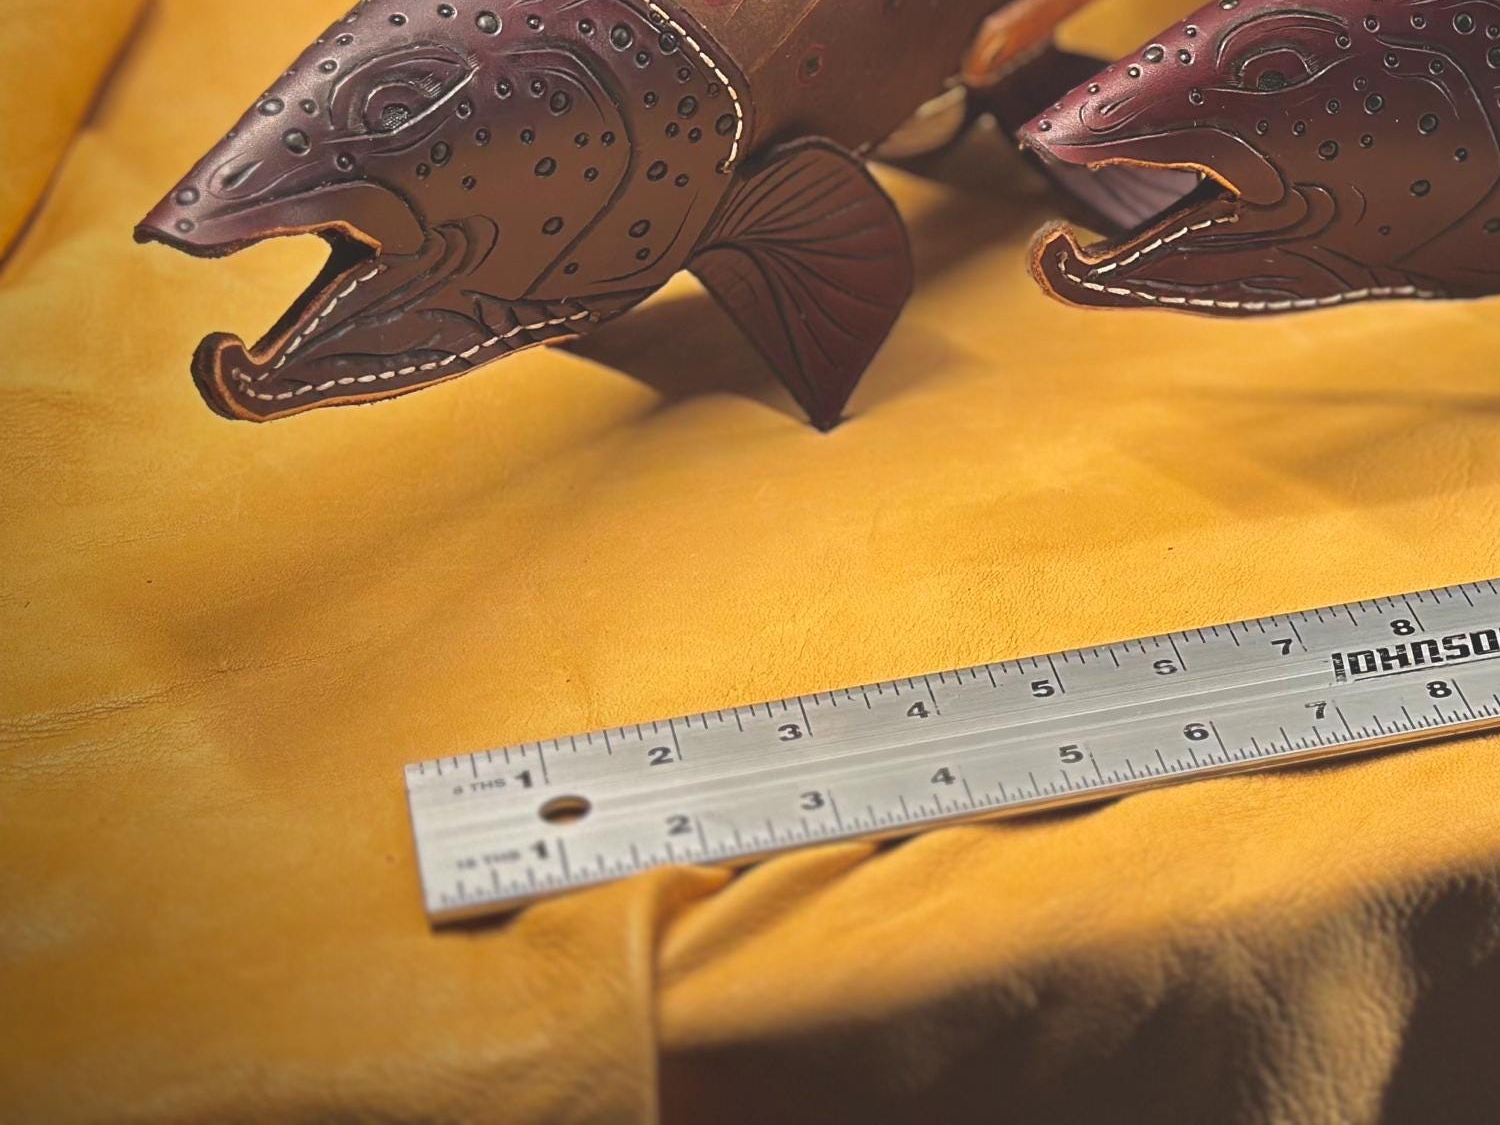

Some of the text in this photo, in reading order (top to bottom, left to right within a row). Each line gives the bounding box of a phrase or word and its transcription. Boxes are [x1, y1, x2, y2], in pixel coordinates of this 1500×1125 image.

[470, 778, 507, 792] THS
[515, 771, 532, 788] 1
[648, 747, 674, 766] 2
[778, 723, 803, 742] 3
[906, 701, 930, 719] 4
[1031, 679, 1055, 698] 5
[1270, 638, 1293, 655] 7
[1390, 619, 1416, 636] 8
[530, 840, 548, 859] 1
[666, 815, 692, 835] 2
[800, 791, 825, 811] 3
[930, 767, 956, 786] 4
[1059, 744, 1084, 764] 5
[1183, 722, 1210, 741] 6
[1305, 700, 1327, 719] 7
[1426, 680, 1452, 698] 8
